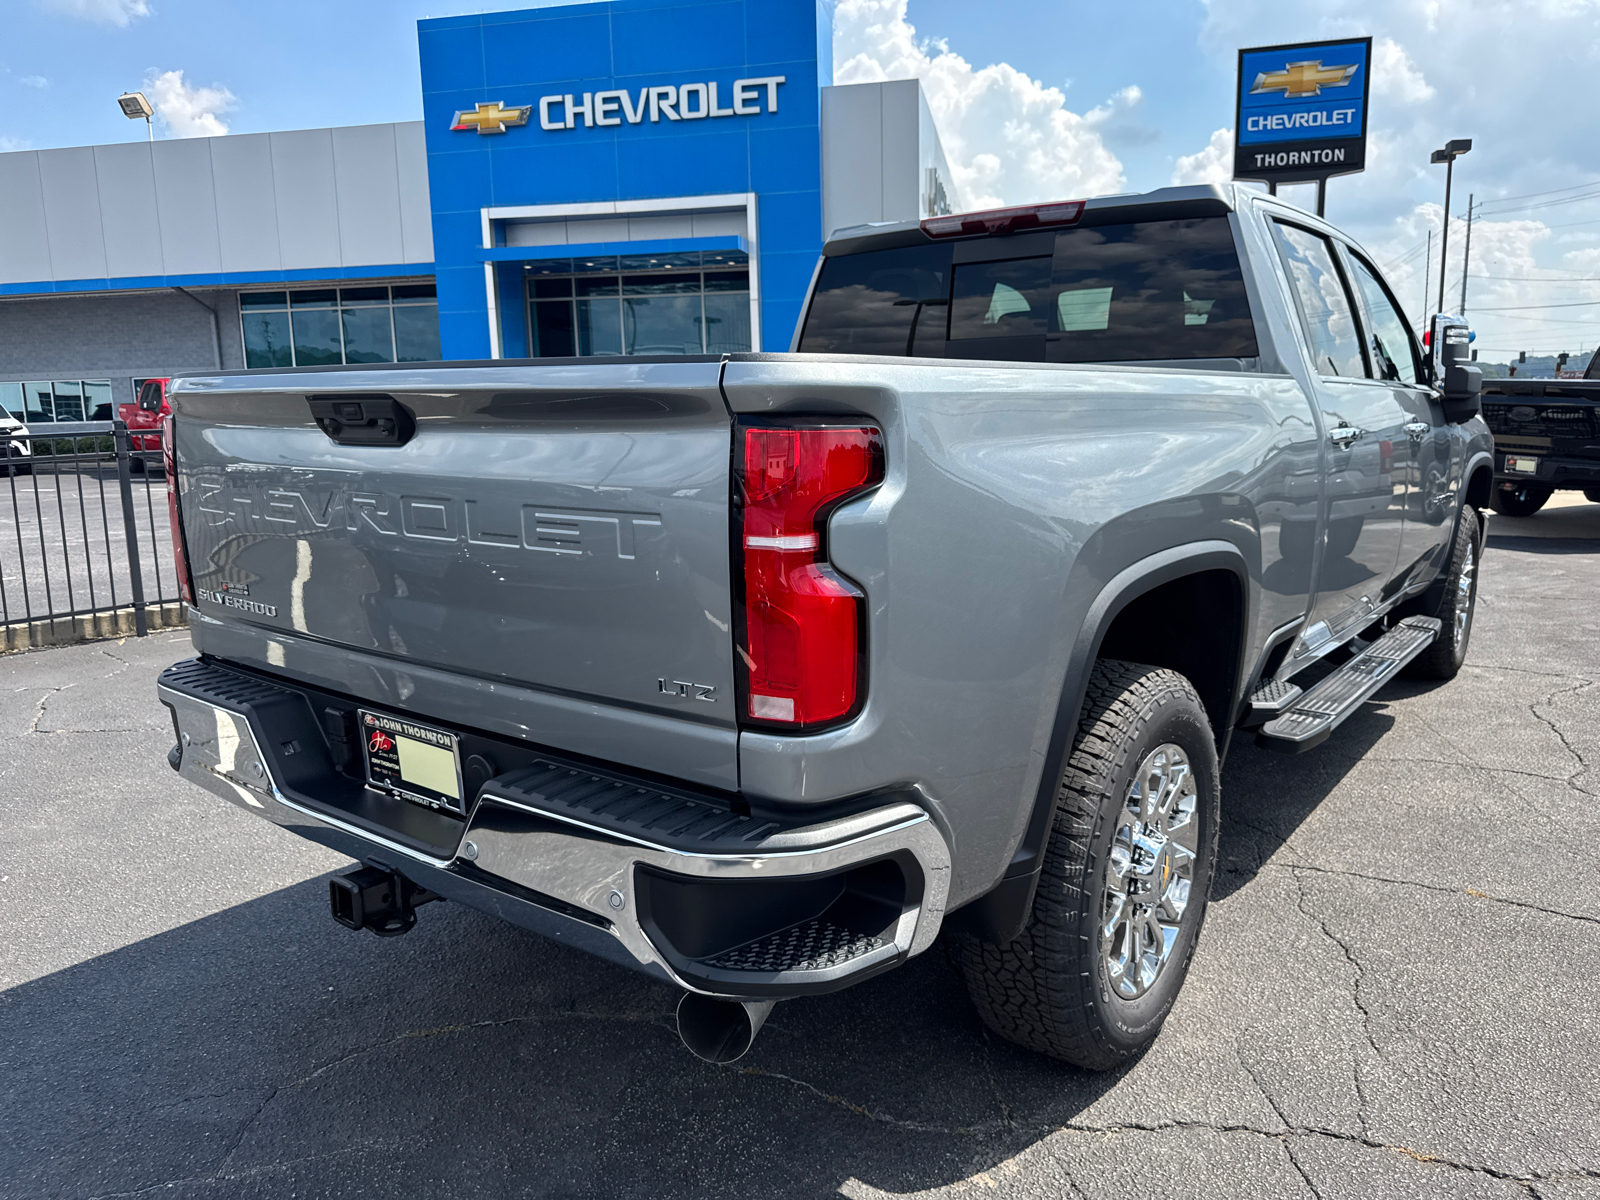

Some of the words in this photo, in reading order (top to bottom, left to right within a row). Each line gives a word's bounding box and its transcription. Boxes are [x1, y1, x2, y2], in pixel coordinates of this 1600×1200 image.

[538, 75, 786, 131] CHEVROLET
[1247, 108, 1356, 132] CHEVROLET
[1254, 148, 1345, 167] THORNTON
[198, 588, 278, 617] SILVERADO
[658, 677, 718, 702] LTZ
[380, 718, 402, 732] JOHN
[403, 724, 451, 746] THORNTON
[401, 793, 429, 806] CHEVROLET
